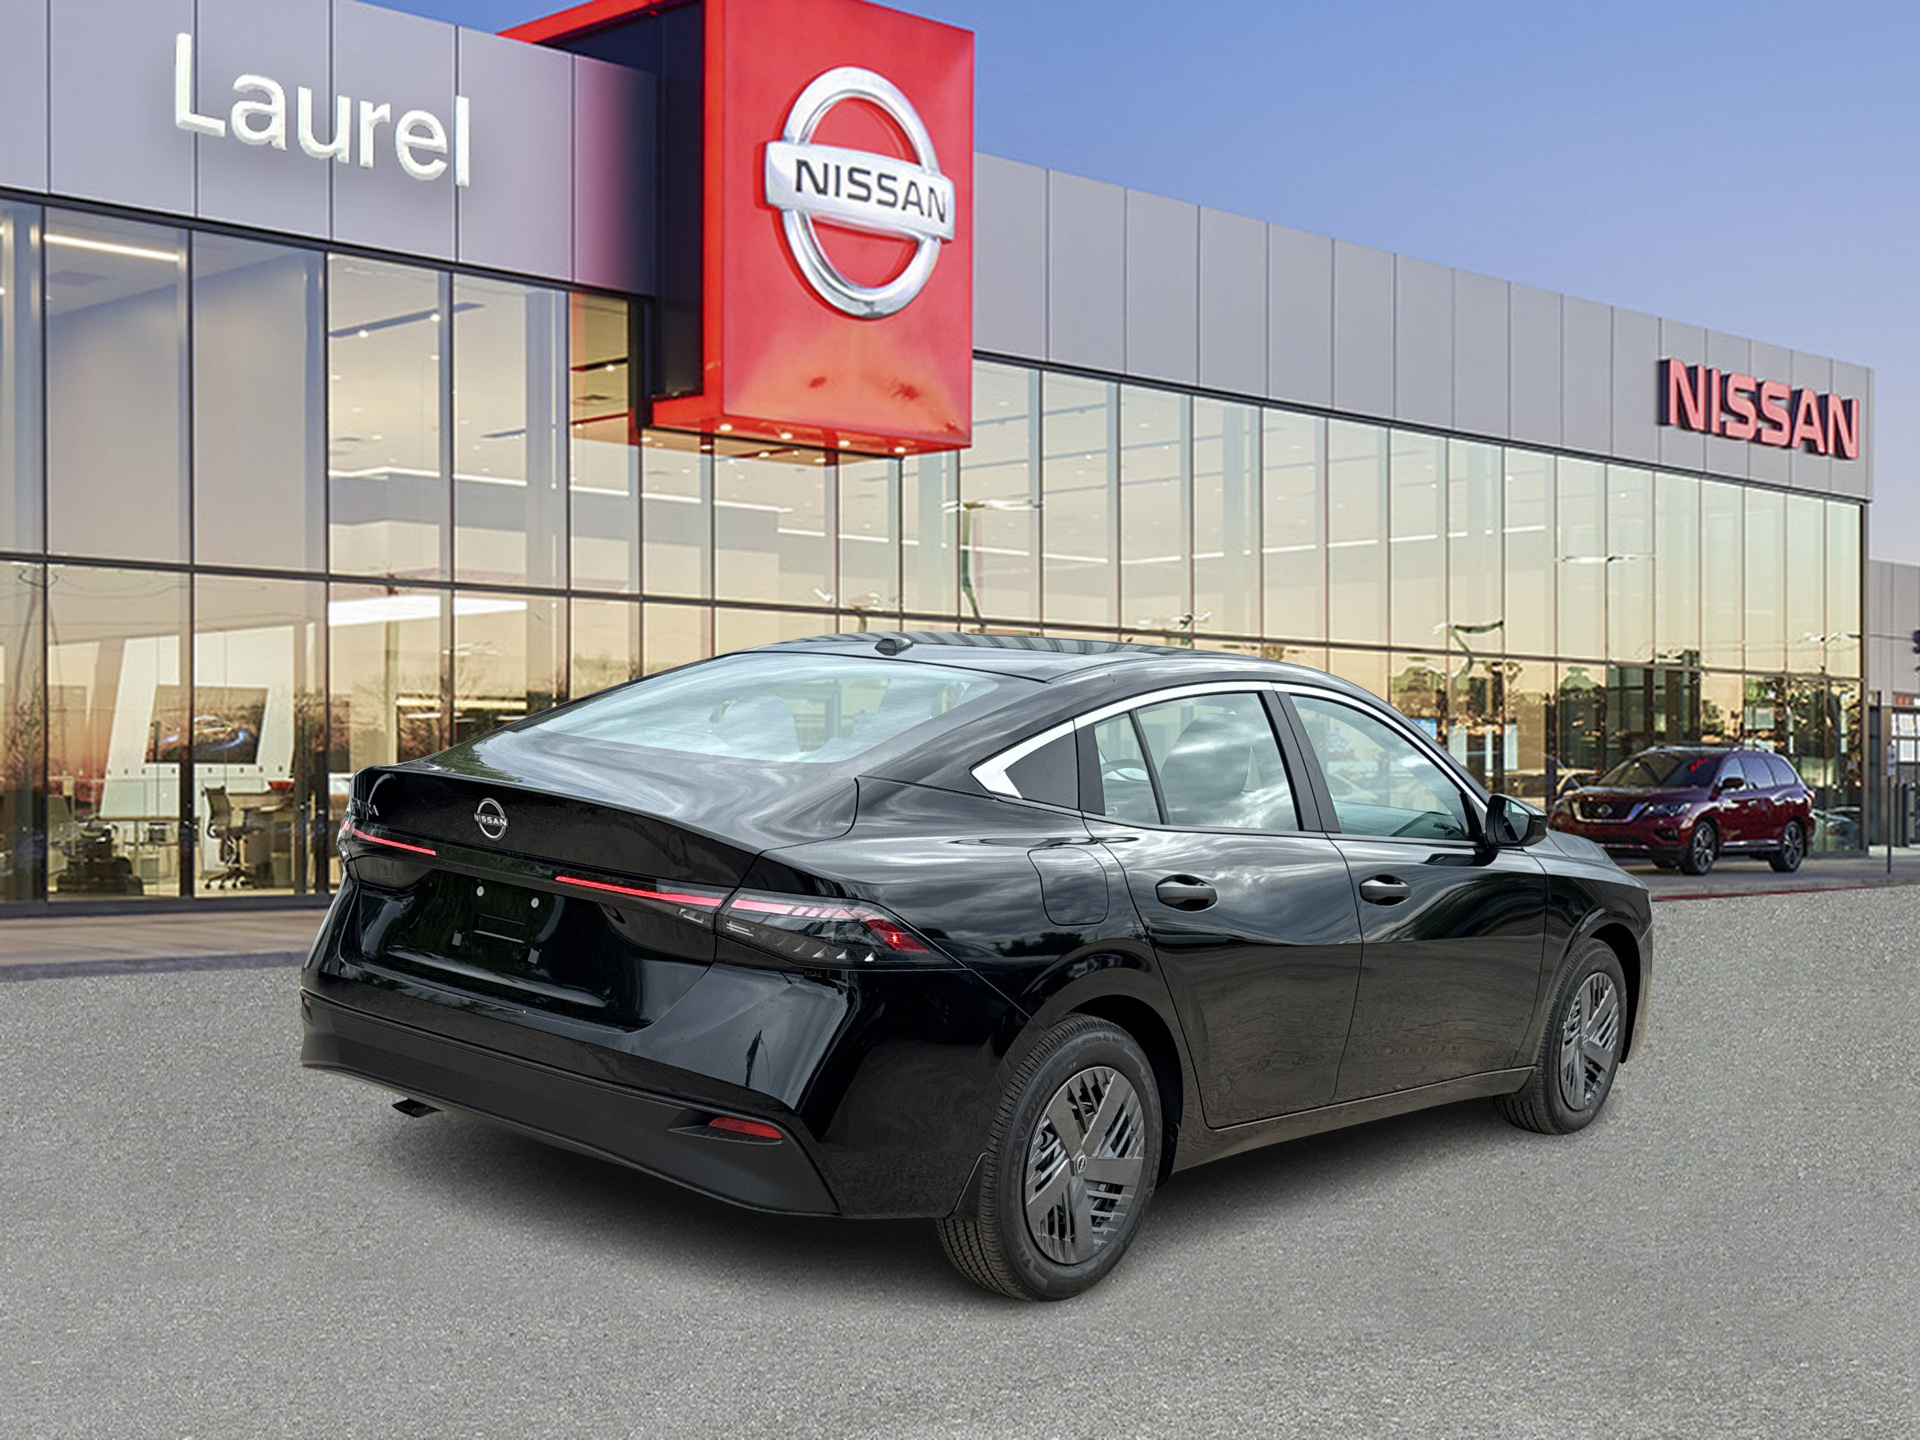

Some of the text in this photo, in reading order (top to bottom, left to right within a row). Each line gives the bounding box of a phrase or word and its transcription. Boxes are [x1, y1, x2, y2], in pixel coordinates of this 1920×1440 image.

[175, 33, 470, 188] Laurel
[795, 159, 946, 224] NISSAN
[1658, 358, 1860, 460] NISSAN
[474, 813, 507, 826] NISSAN
